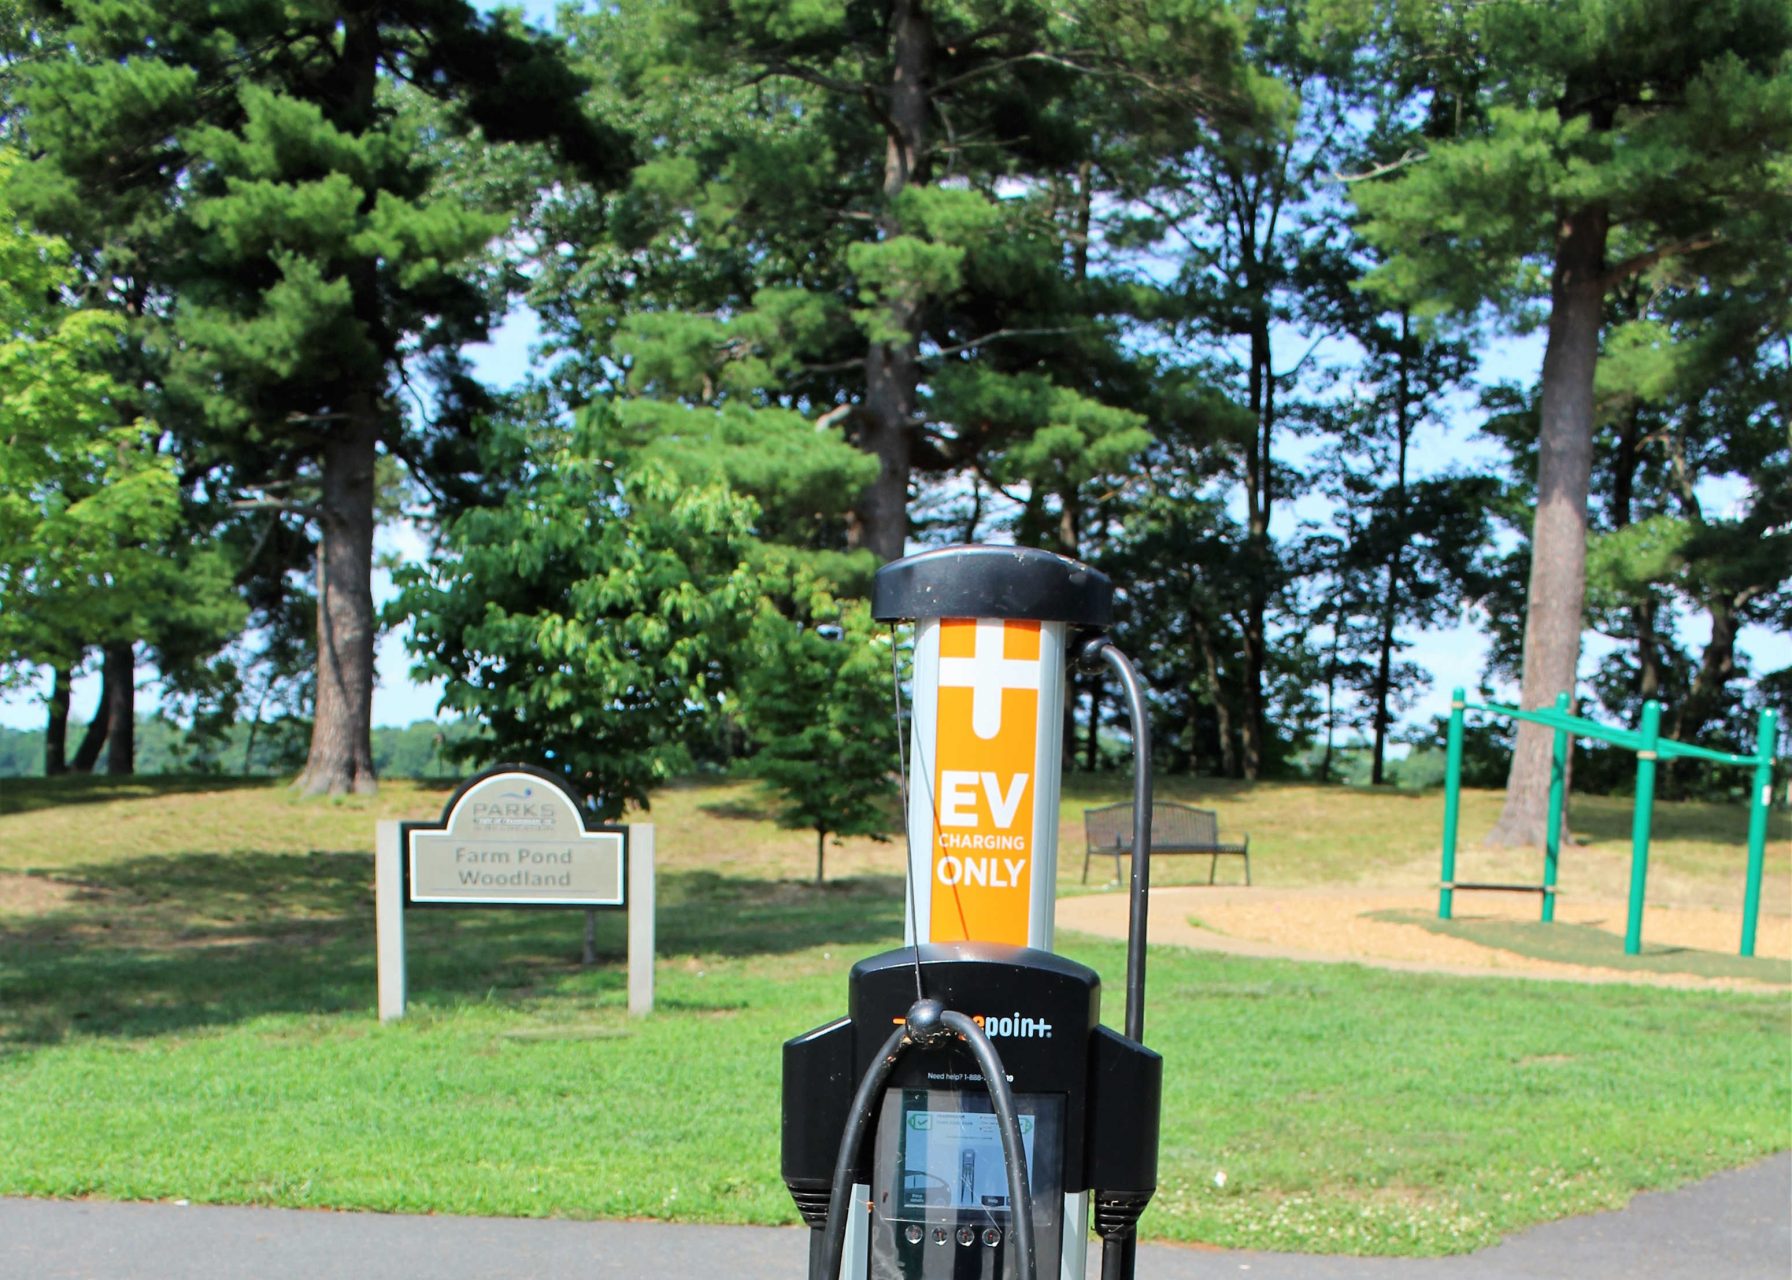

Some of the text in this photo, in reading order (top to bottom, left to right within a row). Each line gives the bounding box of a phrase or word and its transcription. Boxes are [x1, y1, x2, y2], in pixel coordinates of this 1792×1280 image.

[939, 769, 1029, 829] EV
[472, 802, 555, 817] PARKS
[938, 832, 1025, 850] CHARGING
[455, 847, 573, 864] Farm Pond
[458, 869, 572, 886] Woodland
[936, 856, 1026, 888] ONLY
[927, 1072, 945, 1080] Need
